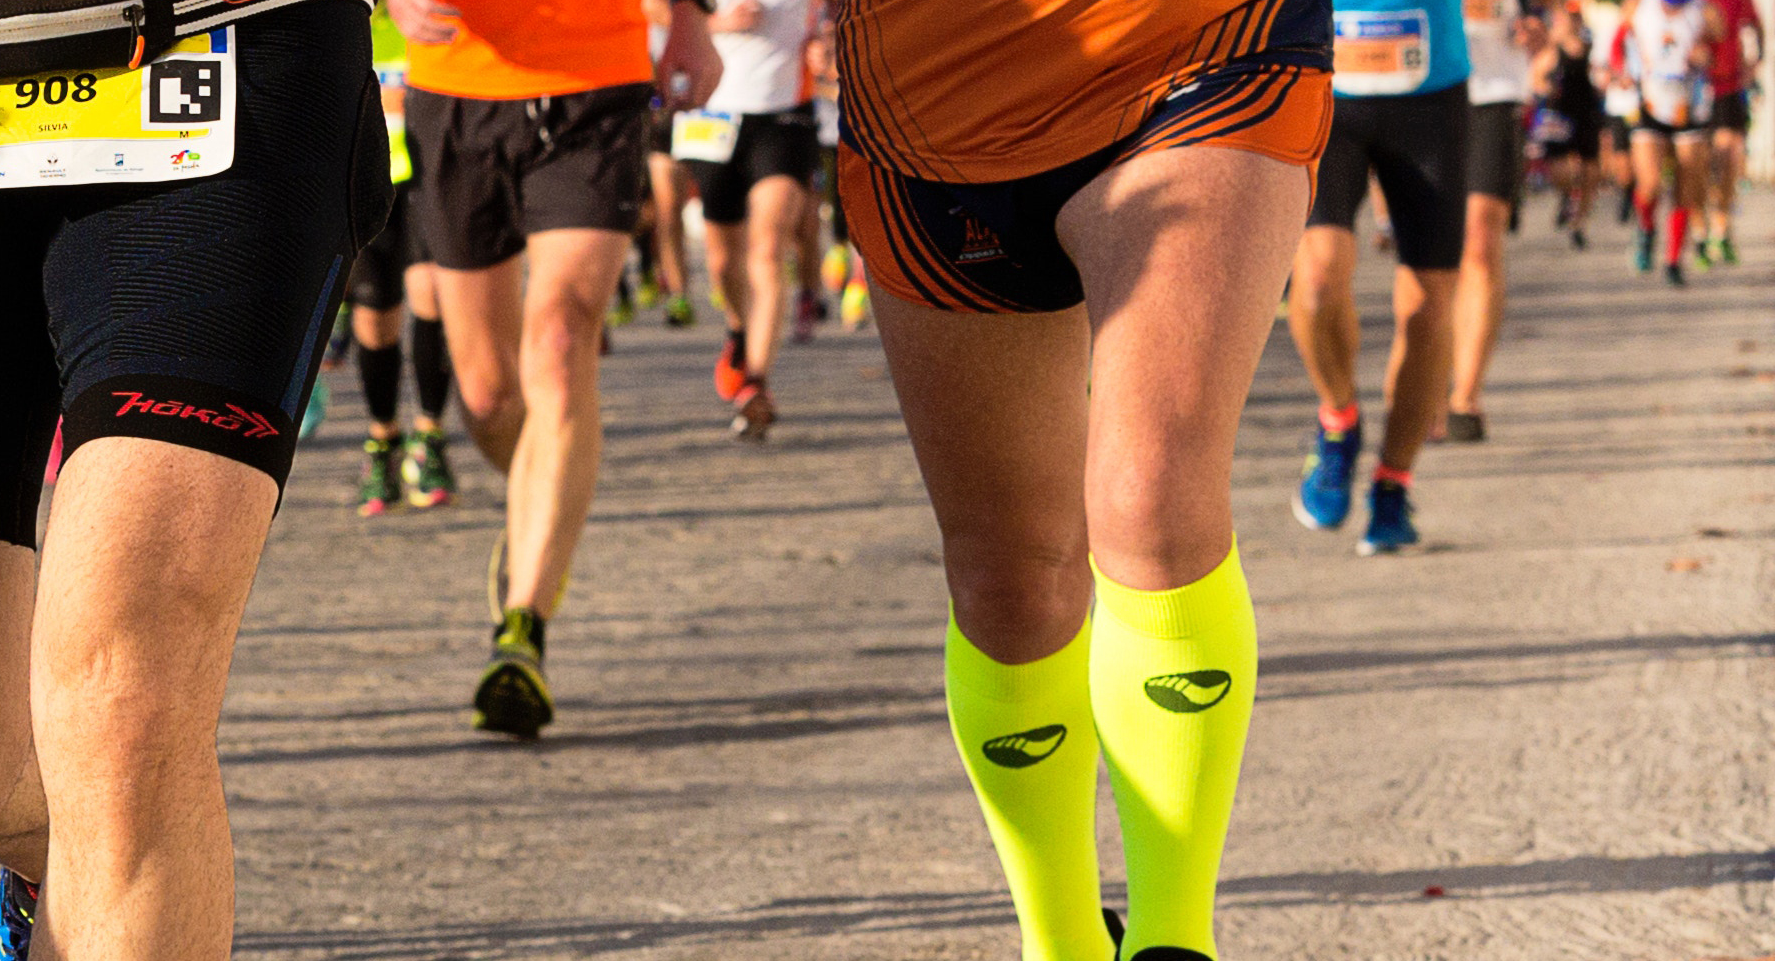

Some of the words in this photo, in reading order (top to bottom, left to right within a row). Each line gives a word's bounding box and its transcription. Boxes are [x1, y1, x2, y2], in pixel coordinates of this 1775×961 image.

[15, 73, 97, 109] 908
[38, 123, 68, 132] SILVIA
[180, 131, 190, 139] M
